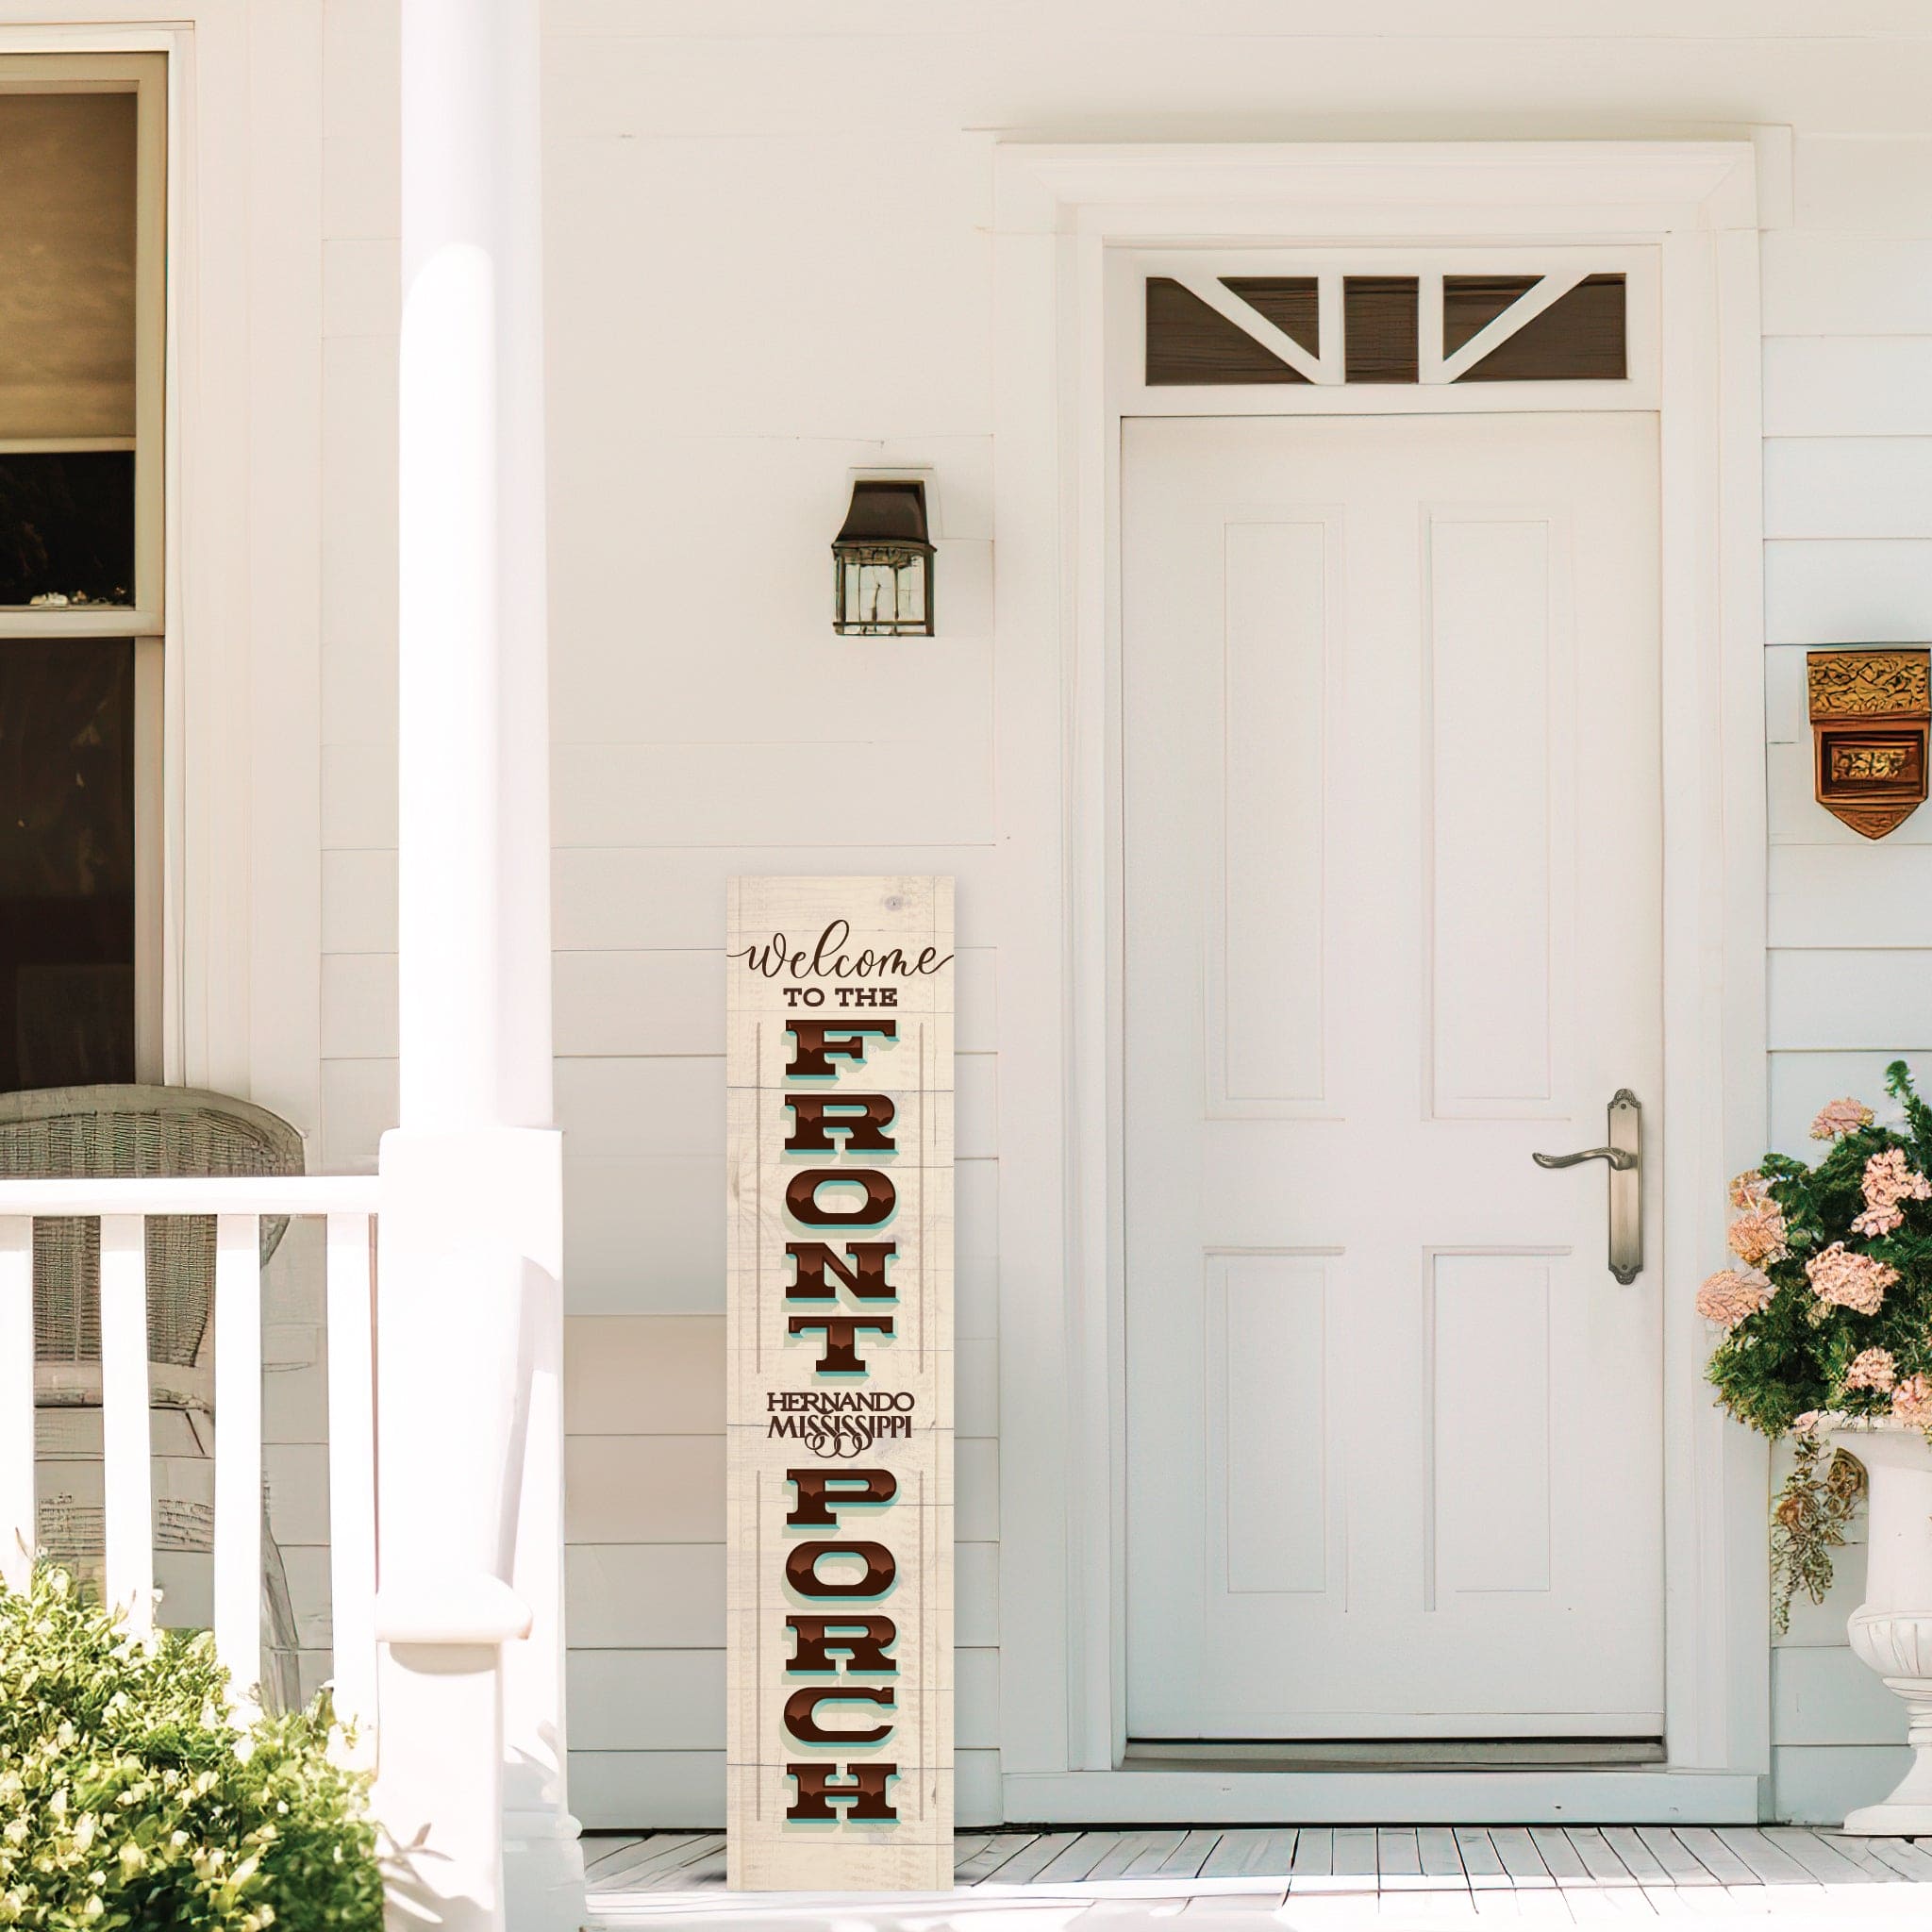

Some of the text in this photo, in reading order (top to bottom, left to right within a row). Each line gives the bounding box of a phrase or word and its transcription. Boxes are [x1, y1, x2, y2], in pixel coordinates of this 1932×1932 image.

[782, 987, 898, 1008] TO THE
[783, 1019, 900, 1379] FRONT
[766, 1391, 915, 1415] HERNANDO
[766, 1414, 912, 1458] MISSISSIPPI
[782, 1468, 901, 1828] PORCH
